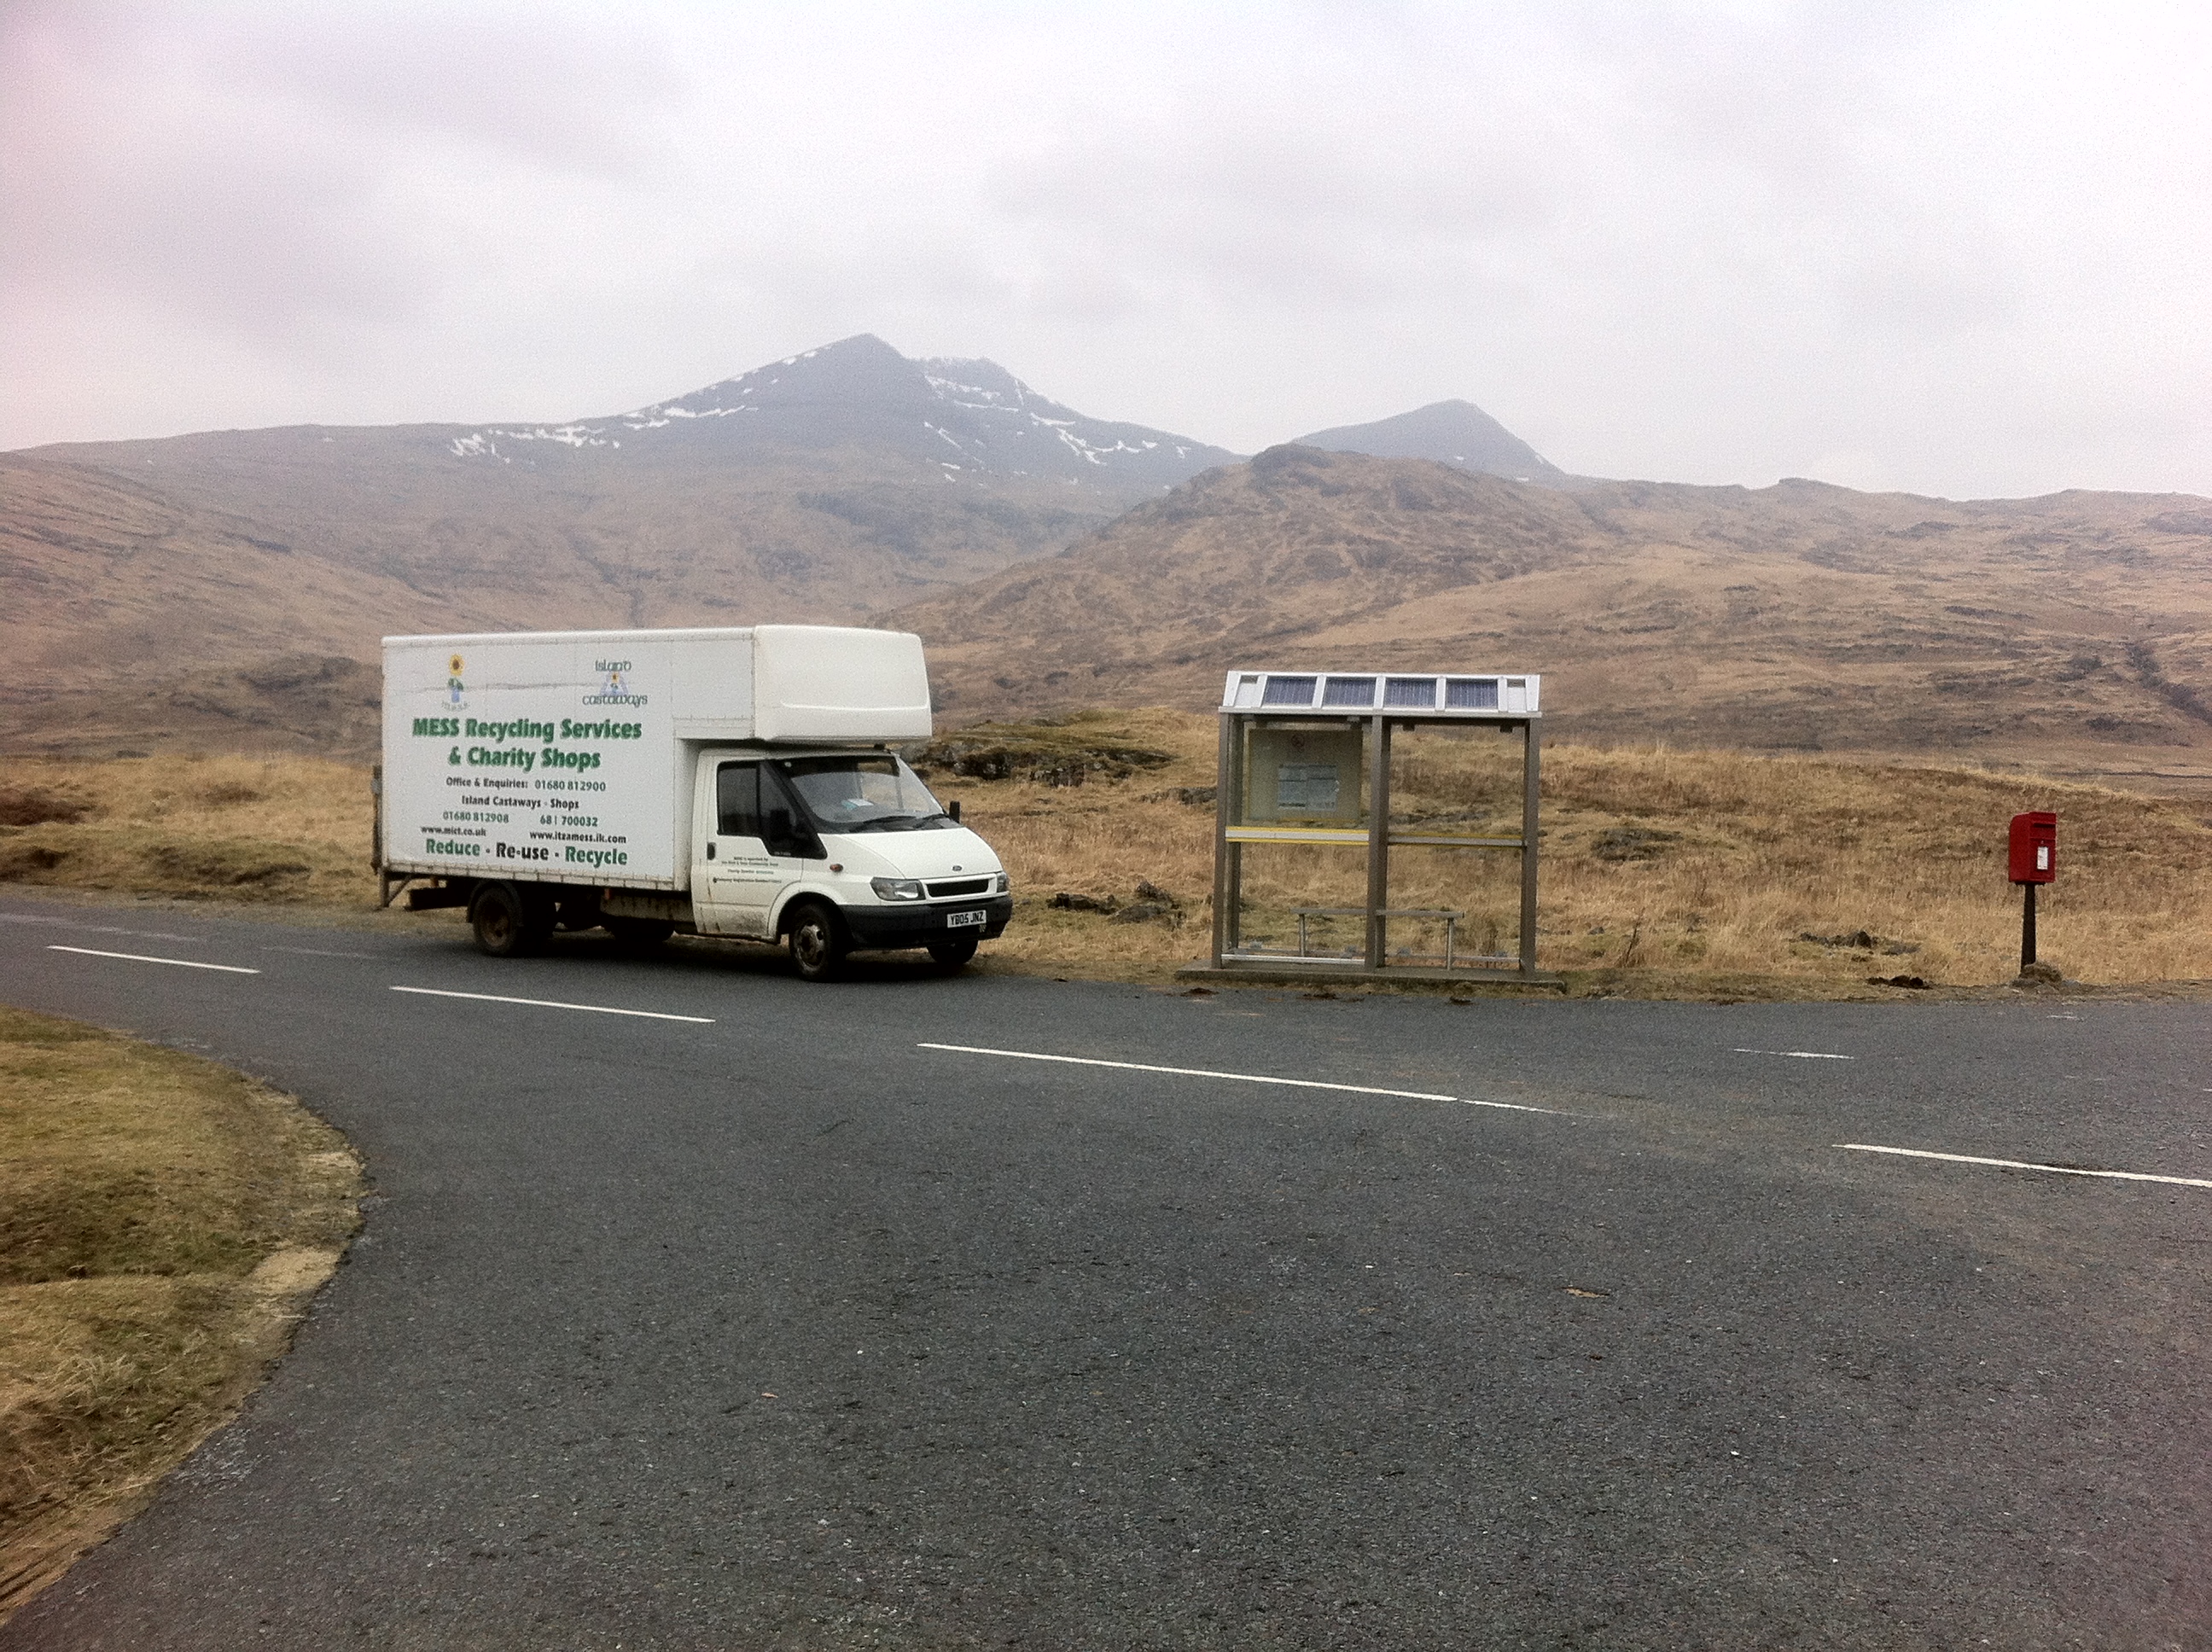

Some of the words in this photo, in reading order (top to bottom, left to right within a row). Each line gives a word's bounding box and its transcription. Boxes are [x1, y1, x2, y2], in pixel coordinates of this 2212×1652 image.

[582, 695, 648, 707] castaways
[413, 718, 460, 737] MESS
[465, 718, 555, 744] Recycling
[560, 718, 642, 739] Services
[448, 746, 461, 765] &
[467, 747, 536, 773] Charity
[541, 747, 601, 773] Shops
[445, 777, 472, 787] Office
[474, 777, 480, 787] &
[483, 777, 528, 790] Enquiries:
[534, 779, 565, 790] 01680
[568, 781, 606, 792] 812900
[462, 795, 490, 806] Island
[492, 796, 541, 810] Castaways
[550, 798, 579, 811] Shops
[443, 811, 471, 821] 01680
[474, 812, 509, 823] 812908
[562, 816, 598, 827] 700032
[426, 838, 480, 857] Reduce
[565, 846, 628, 869] Recycle
